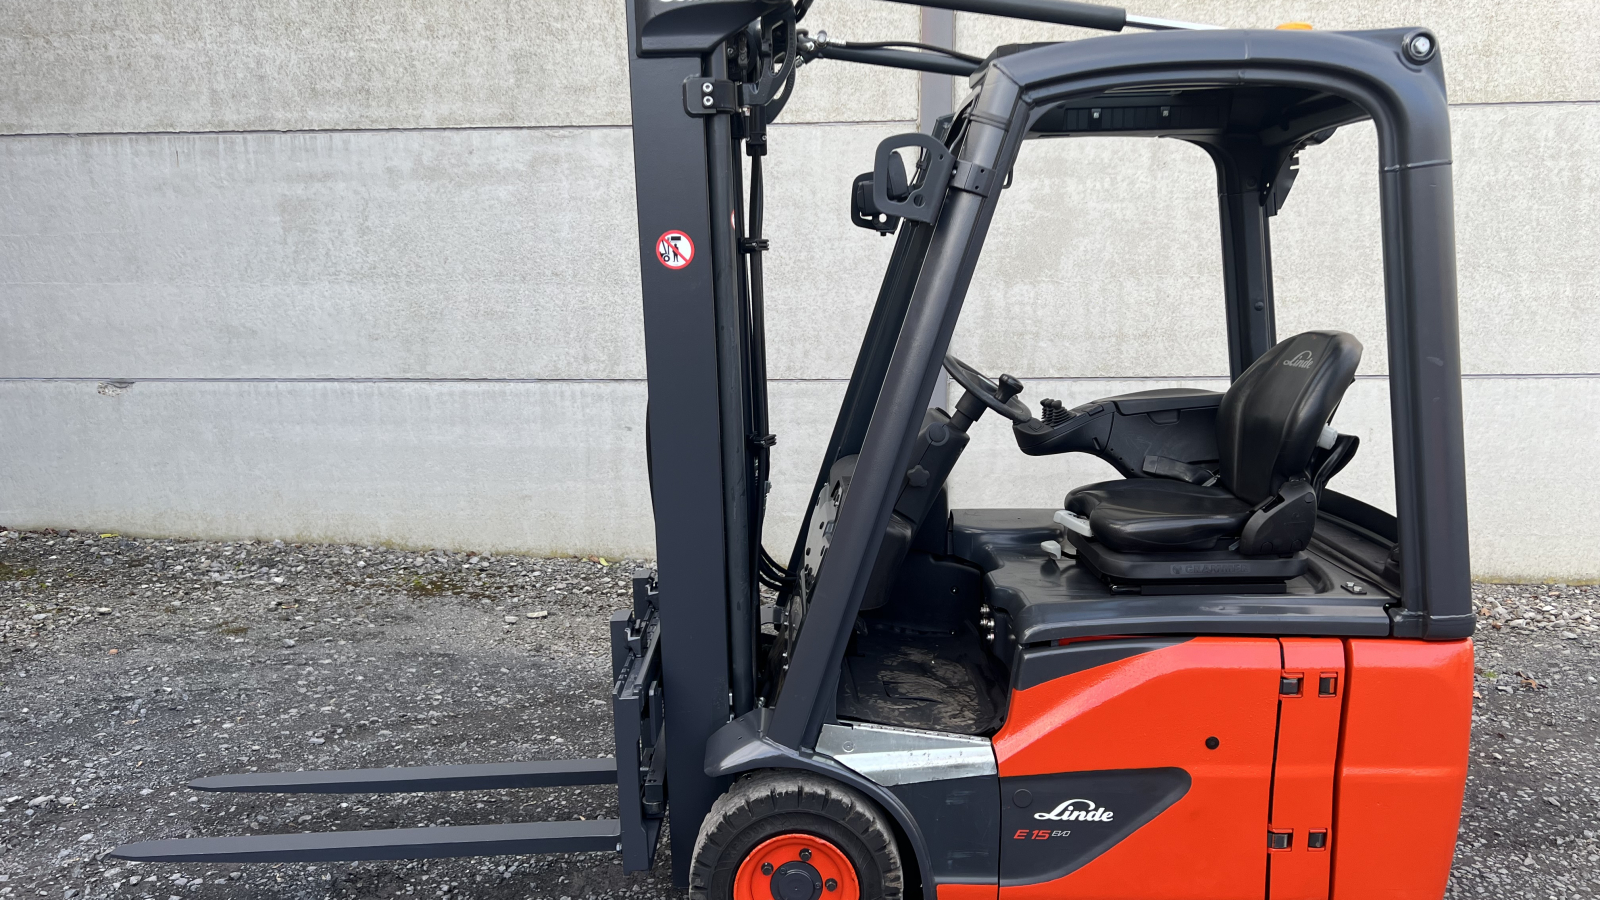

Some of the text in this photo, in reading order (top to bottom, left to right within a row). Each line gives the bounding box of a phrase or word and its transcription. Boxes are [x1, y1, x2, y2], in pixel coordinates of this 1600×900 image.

[1283, 350, 1314, 369] Linde
[1033, 798, 1114, 822] Linde
[1013, 829, 1030, 840] E
[1031, 829, 1052, 840] 15
